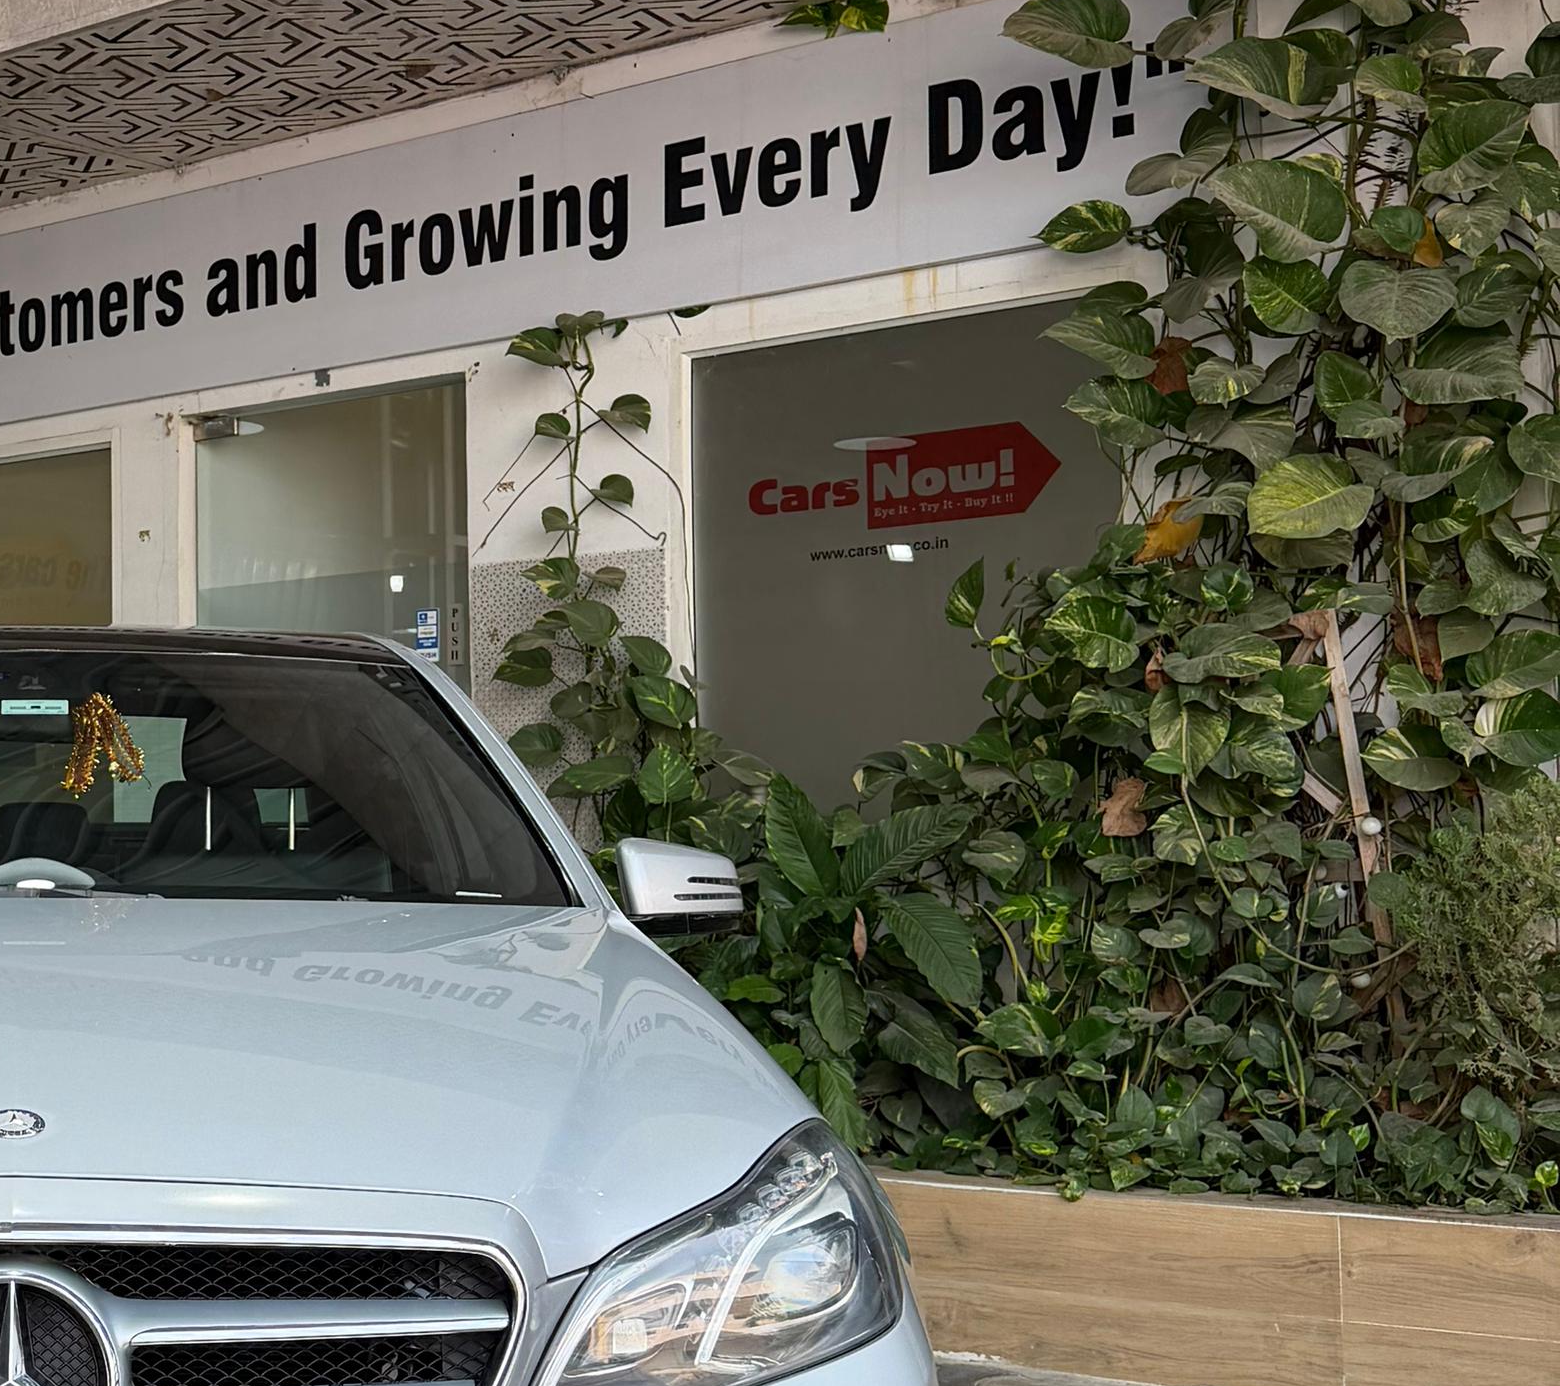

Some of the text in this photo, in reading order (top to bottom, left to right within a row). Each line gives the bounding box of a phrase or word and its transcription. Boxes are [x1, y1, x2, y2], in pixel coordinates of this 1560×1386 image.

[206, 222, 317, 318] and
[344, 173, 629, 290] Growing
[665, 116, 892, 228] Every
[748, 448, 1015, 516] Cars Now!
[873, 507, 896, 519] Eye
[919, 502, 940, 513] Try
[943, 500, 953, 509] It
[965, 497, 988, 509] Buy
[991, 495, 1001, 504] It
[809, 536, 950, 562] www.carsnco.in
